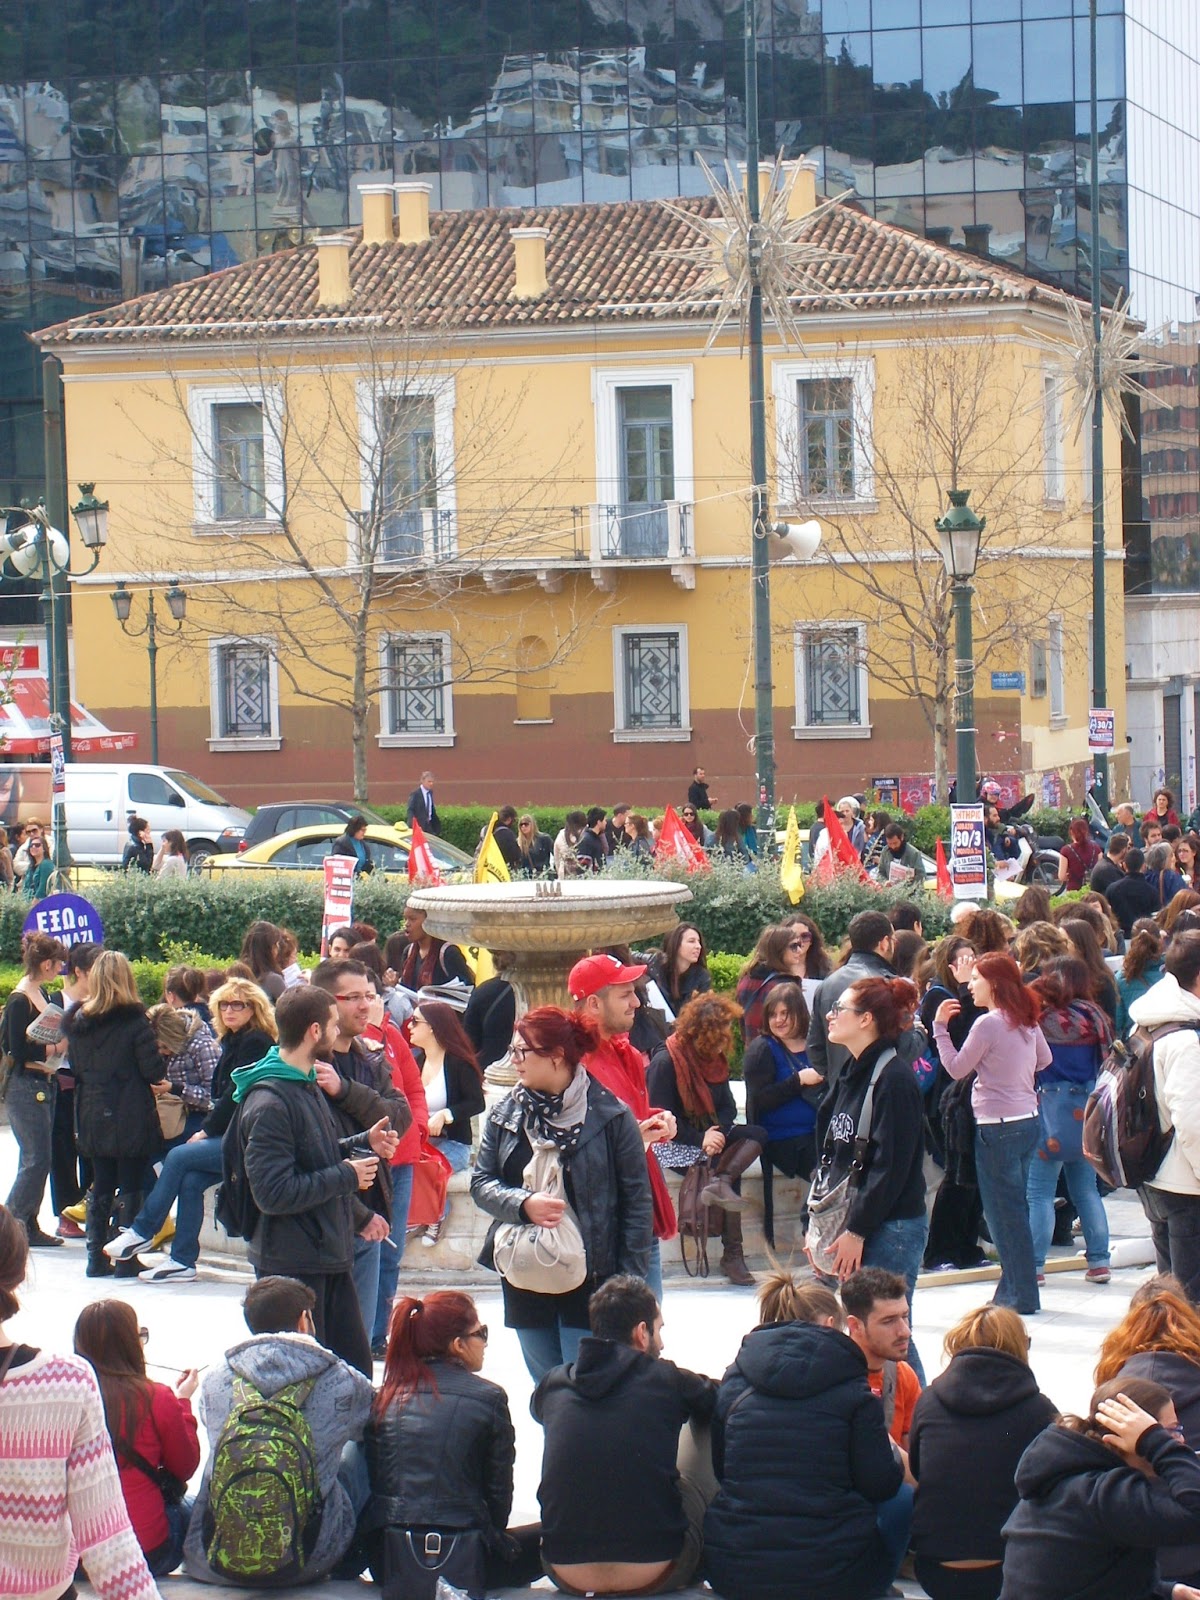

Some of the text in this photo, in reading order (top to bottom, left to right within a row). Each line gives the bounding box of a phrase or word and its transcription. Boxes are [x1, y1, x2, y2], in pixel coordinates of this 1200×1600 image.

[1097, 720, 1113, 729] 30/3
[956, 830, 982, 848] 30/3
[36, 907, 76, 933] ΕΞΩ
